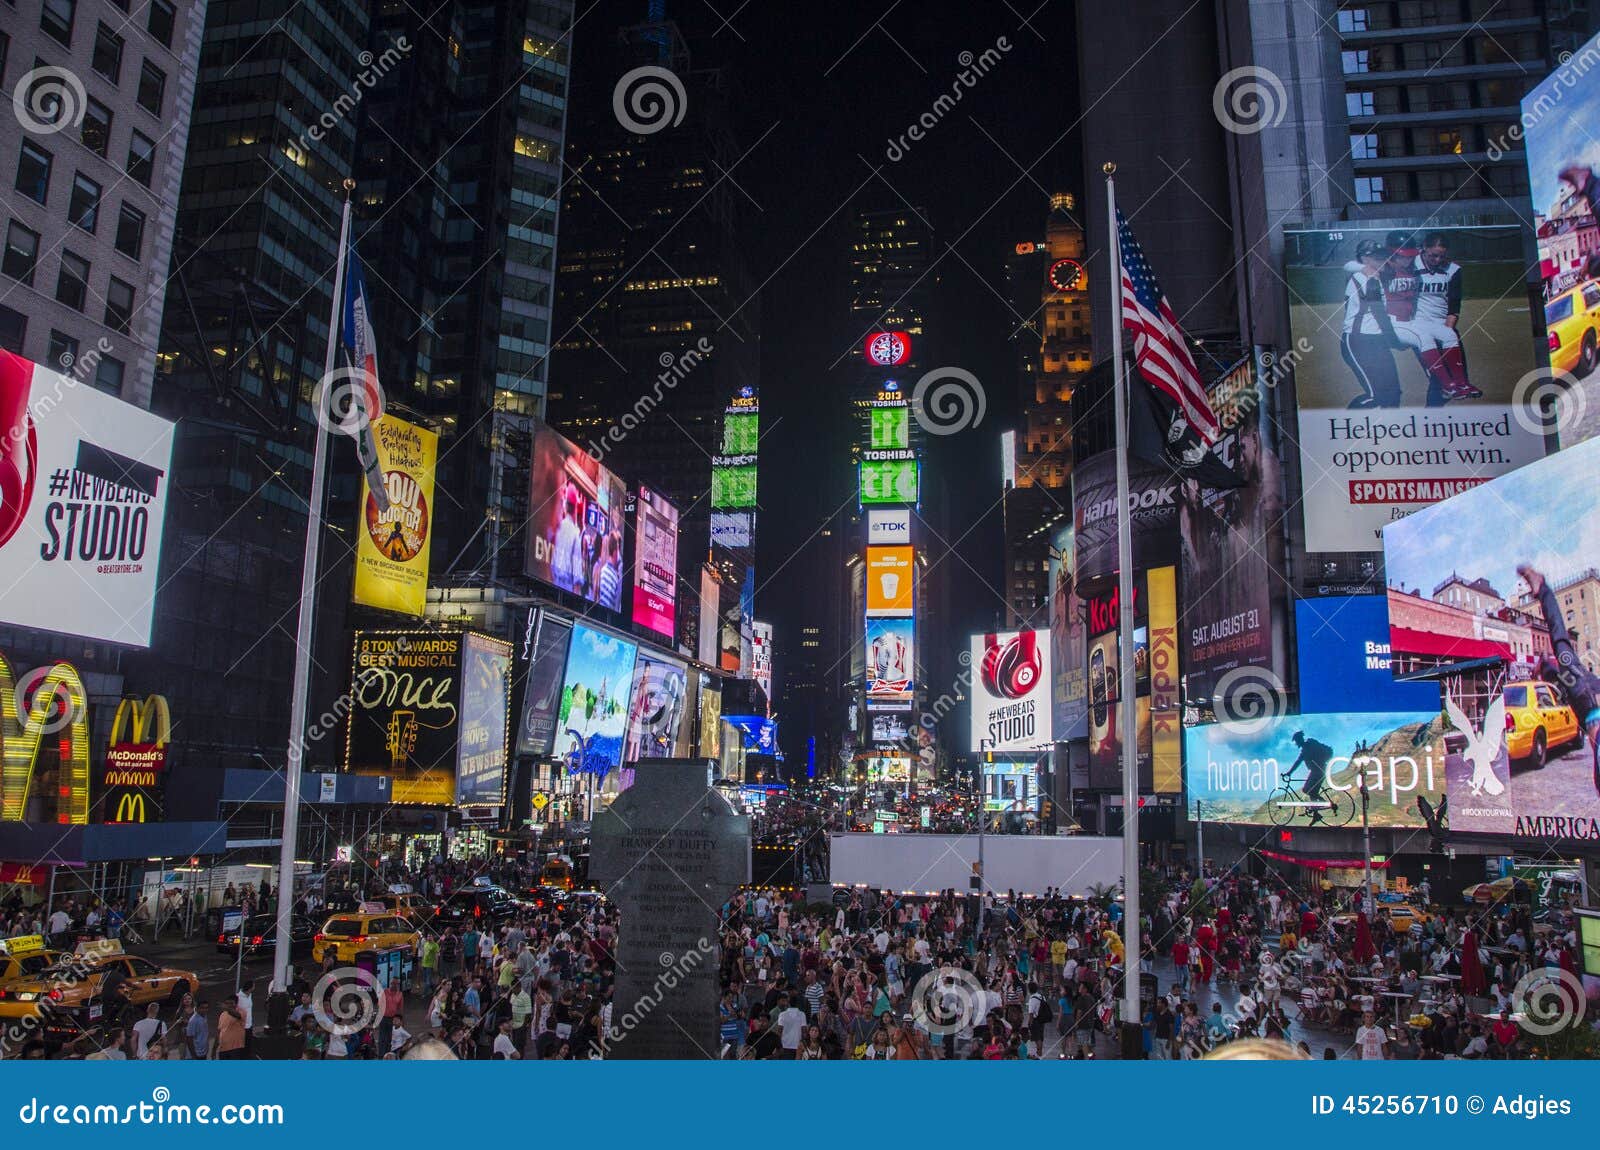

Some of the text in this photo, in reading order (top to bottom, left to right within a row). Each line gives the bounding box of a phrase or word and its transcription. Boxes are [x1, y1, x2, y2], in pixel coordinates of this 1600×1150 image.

[1329, 232, 1343, 241] 215
[878, 392, 901, 400] 2013
[1328, 413, 1511, 446] Helped injured
[864, 450, 914, 460] TOSHIBA
[1333, 441, 1512, 473] opponent win.
[49, 468, 151, 504] #NEWBEA
[1353, 480, 1486, 501] SPORTSMANS
[1130, 506, 1176, 521] motion
[40, 501, 149, 562] STUDIO
[880, 522, 906, 531] TDK
[1193, 609, 1260, 646] SAT. AUGUST 31
[362, 641, 369, 651] 8
[371, 641, 404, 651] TONY
[405, 641, 457, 652] AWARDS
[1365, 641, 1391, 654] Ban
[360, 655, 457, 668] BEST MUSICAL
[1366, 657, 1392, 669] Mer
[1152, 626, 1178, 734] Kodak
[989, 700, 1035, 722] #NEWBEATS
[988, 713, 1036, 746] STUDIO
[107, 751, 163, 761] McDonald's
[1208, 744, 1446, 805] human capi
[680, 838, 718, 850] DUFFY
